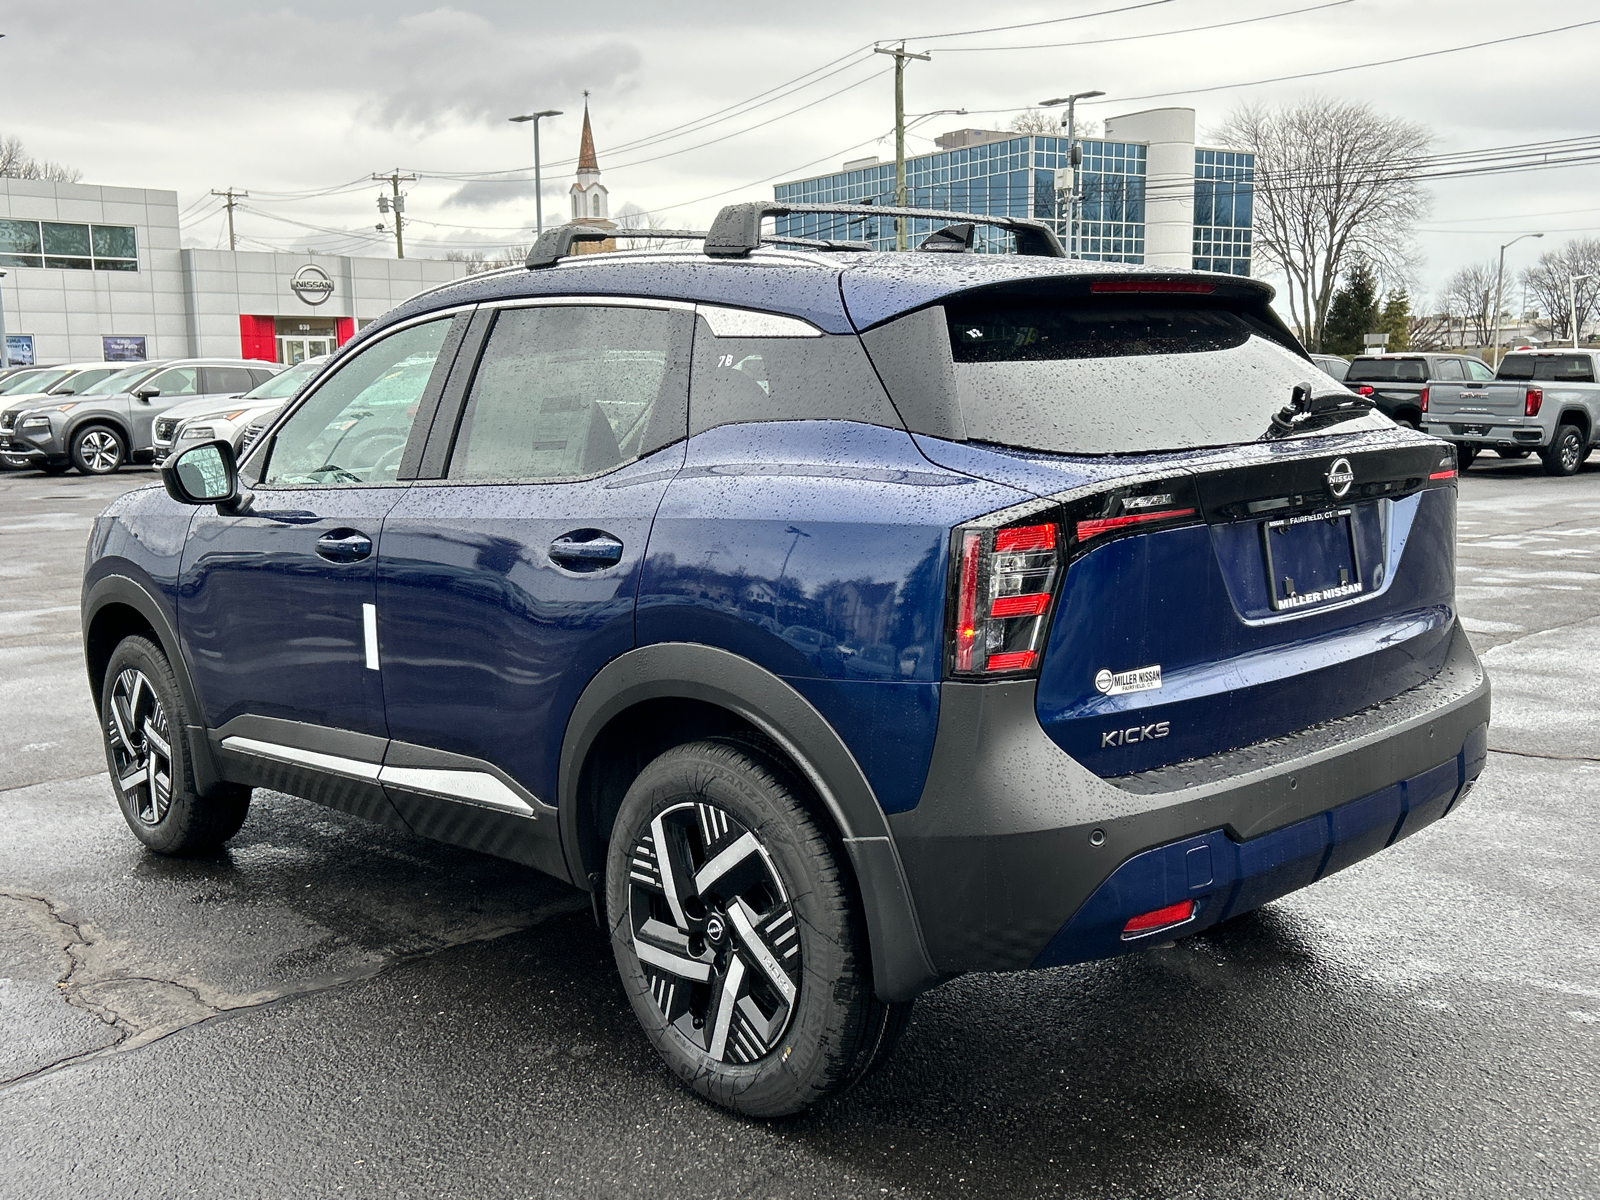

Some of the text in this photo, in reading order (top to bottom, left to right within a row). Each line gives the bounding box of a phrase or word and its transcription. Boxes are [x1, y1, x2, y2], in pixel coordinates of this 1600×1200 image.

[295, 280, 332, 289] NISSAN
[1459, 391, 1489, 399] GMC
[1328, 473, 1354, 484] NISSAN
[1290, 514, 1323, 524] FAIRFIELD,
[1278, 582, 1363, 610] MILLER NISSAN
[1114, 669, 1161, 687] MILLER NISSAN
[1101, 721, 1170, 748] KICKS
